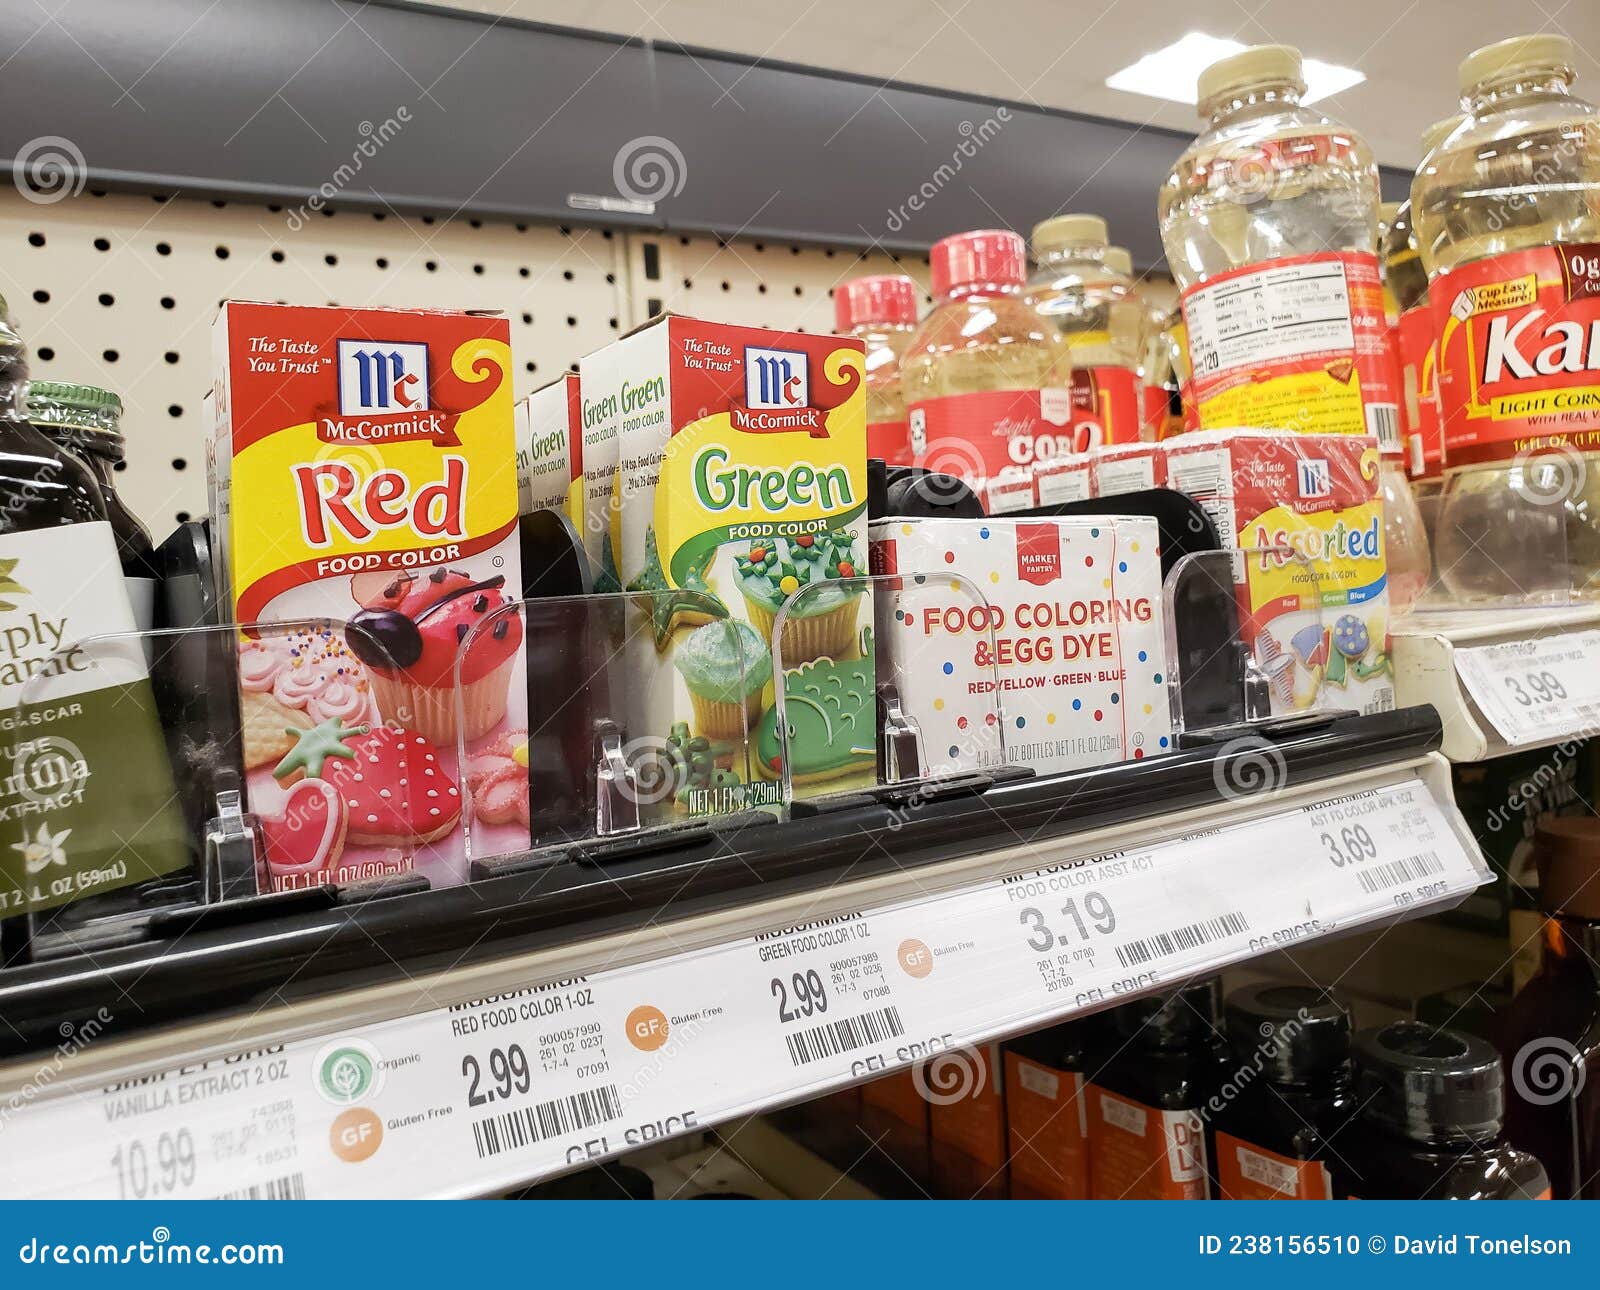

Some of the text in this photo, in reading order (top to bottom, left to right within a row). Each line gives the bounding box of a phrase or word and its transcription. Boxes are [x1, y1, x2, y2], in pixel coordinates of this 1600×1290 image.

[1477, 292, 1532, 311] Measure!
[1478, 282, 1530, 300] Cup Easy
[248, 336, 319, 355] The Taste
[683, 338, 732, 356] The Taste
[248, 357, 277, 374] You
[683, 355, 703, 372] You
[1203, 351, 1219, 370] 120
[620, 375, 666, 415] Green
[583, 393, 618, 430] Green
[622, 410, 665, 433] FOOD COLOR
[531, 428, 566, 462] Green
[585, 425, 618, 447] FOOD COLOR
[533, 462, 547, 477] FOOD
[547, 457, 566, 474] COLOR
[692, 446, 855, 511] Green
[294, 457, 466, 547] Red
[728, 519, 829, 540] FOOD COLOR
[1256, 517, 1380, 570] Assorted
[317, 544, 461, 577] FOOD COLOR
[1021, 553, 1058, 566] MARKET
[923, 597, 1152, 636] FOOD COLORING
[1062, 632, 1114, 661] DYE
[1053, 671, 1092, 687] GREEN
[1098, 668, 1127, 683] BLUE
[1504, 670, 1568, 706] 3.99
[1021, 742, 1054, 761] BOTTLES
[1055, 740, 1069, 757] NET
[1319, 823, 1377, 868] 3.69
[50, 876, 75, 896] OZ
[75, 860, 127, 889] (59mL)
[1006, 879, 1047, 902] FOOD
[1050, 868, 1097, 892] COLOR
[1098, 862, 1130, 880] ASST
[1018, 891, 1117, 953] 3.19
[758, 940, 791, 962] GREEN
[791, 934, 818, 956] FOOD
[818, 926, 849, 949] COLOR
[857, 922, 871, 939] OZ
[829, 951, 879, 972] 900057989
[1036, 947, 1095, 972] 261 02 0780
[831, 973, 846, 985] 261
[849, 968, 861, 980] 02
[770, 968, 828, 1024] 2.99
[452, 1017, 479, 1037] RED
[482, 1005, 518, 1029] FOOD
[519, 995, 564, 1022] COLOR
[565, 988, 595, 1010] 1-OZ
[670, 1005, 723, 1027] Gluten Free
[538, 1022, 602, 1047] 900057990
[635, 1018, 660, 1038] GF
[539, 1034, 605, 1061] 261 02 0237
[376, 1053, 422, 1071] Organic
[542, 1058, 569, 1073] 1-7-4
[576, 1060, 611, 1080] 07091
[462, 1043, 531, 1107] 2.99
[103, 1091, 173, 1123] VANILLA
[177, 1070, 251, 1102] EXTRACT
[254, 1067, 266, 1085] 2
[268, 1059, 289, 1082] OZ
[387, 1104, 453, 1131] Gluten Free
[340, 1122, 373, 1148] GF
[110, 1127, 198, 1200] 10.99
